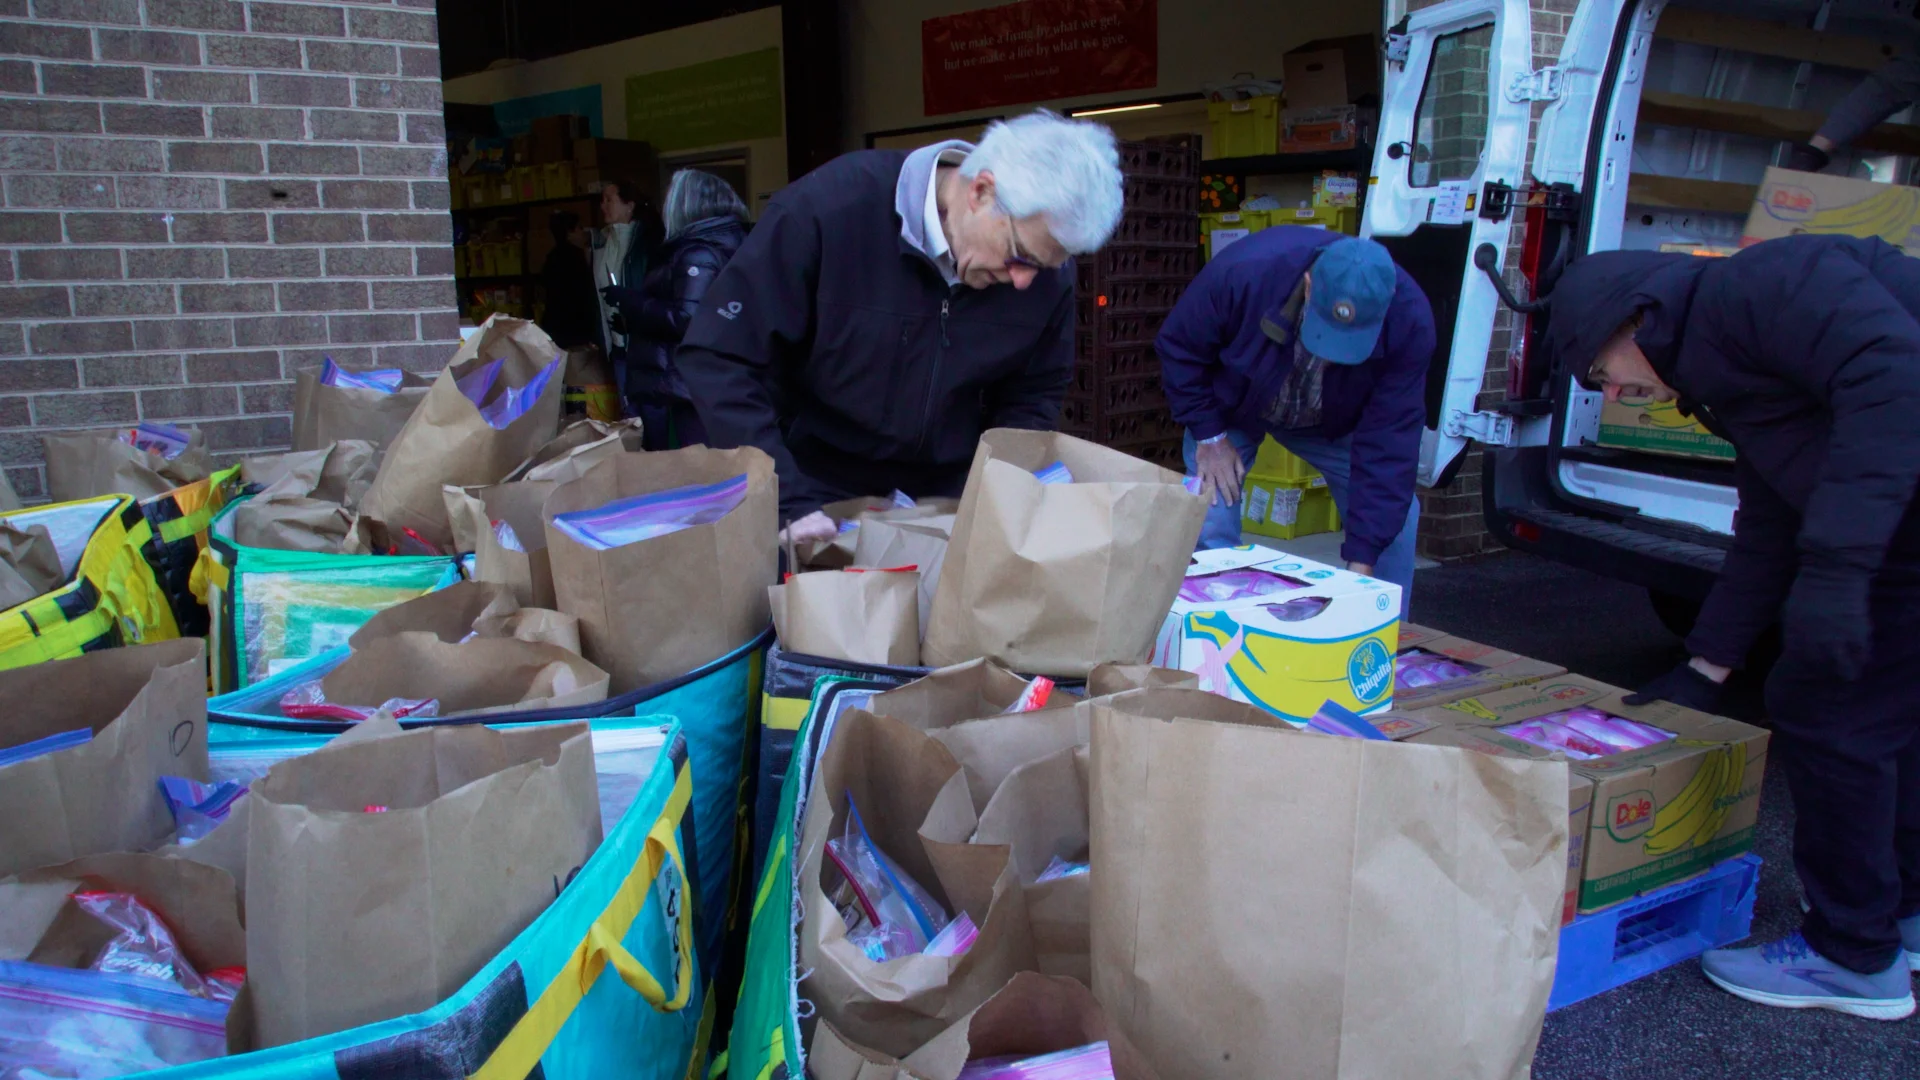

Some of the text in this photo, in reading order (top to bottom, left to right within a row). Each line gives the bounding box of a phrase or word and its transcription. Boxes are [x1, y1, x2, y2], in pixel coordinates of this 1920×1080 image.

[950, 41, 966, 52] We
[969, 36, 994, 48] make
[997, 35, 1002, 43] a
[1006, 31, 1033, 42] living
[1036, 25, 1050, 38] by
[1053, 21, 1078, 34] what
[1081, 19, 1096, 29] we
[944, 58, 960, 70] but
[963, 57, 977, 67] we
[979, 50, 1005, 63] make
[1009, 52, 1015, 60] a
[1018, 47, 1033, 58] life
[1036, 43, 1049, 57] by
[1053, 40, 1078, 53] what
[1082, 38, 1097, 48] we
[1355, 661, 1392, 699] Chiquita
[1616, 798, 1652, 825] Dole
